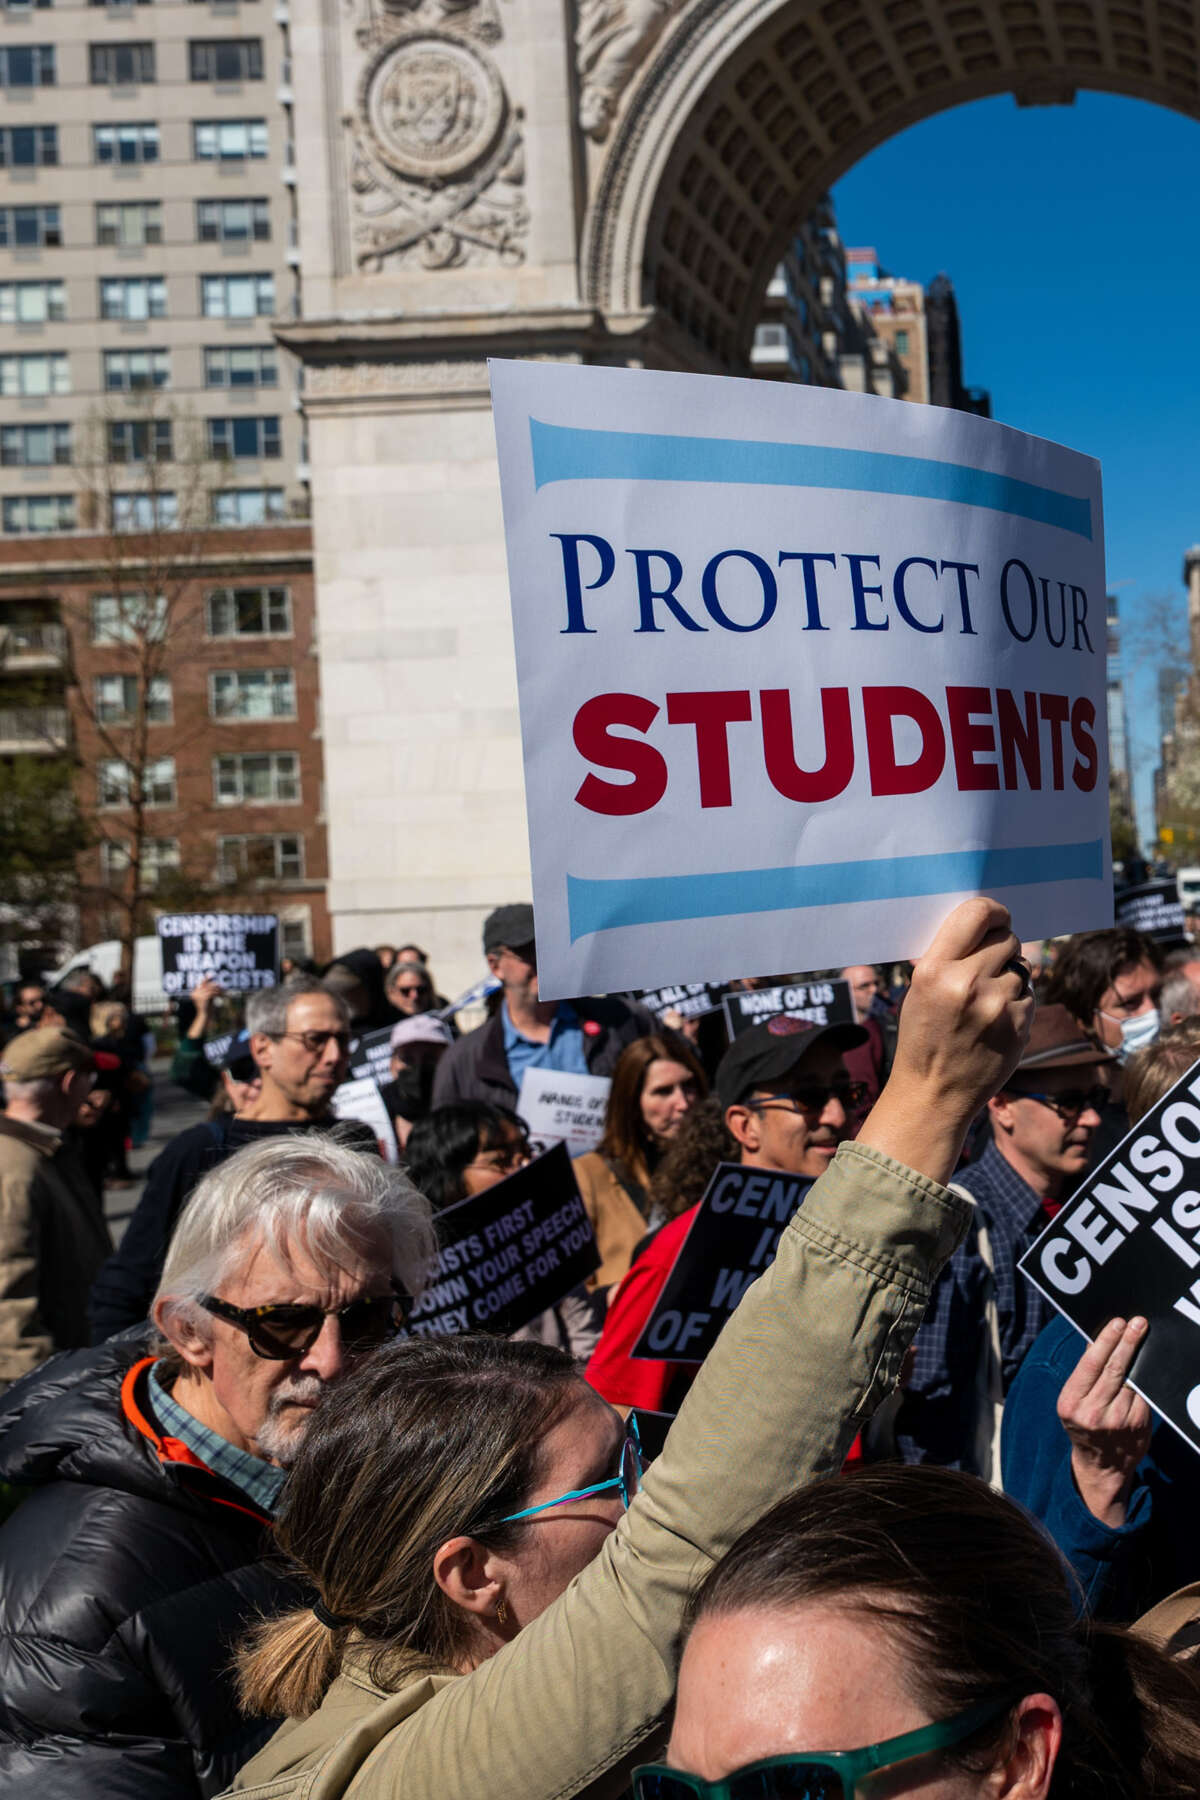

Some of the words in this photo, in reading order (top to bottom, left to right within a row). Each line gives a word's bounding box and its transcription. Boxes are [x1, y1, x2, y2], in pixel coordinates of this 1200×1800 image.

[550, 533, 980, 635] PROTECT
[1000, 558, 1095, 654] OUR
[572, 686, 1098, 816] STUDENTS
[158, 914, 278, 938] CENSORSHIP
[182, 934, 203, 953] IS
[204, 933, 247, 953] THE
[163, 970, 185, 993] OF
[175, 951, 256, 972] WEAPON
[740, 987, 784, 1015] NONE
[783, 987, 808, 1010] OF
[808, 983, 835, 1006] US
[468, 1243, 523, 1289] YOUR
[521, 1196, 584, 1256] SPEECH
[483, 1200, 535, 1249] FIRST
[410, 1305, 471, 1339] THEY
[472, 1273, 527, 1320] COME
[524, 1247, 561, 1286] FOR
[559, 1219, 594, 1257] YOU
[647, 1309, 711, 1352] OF
